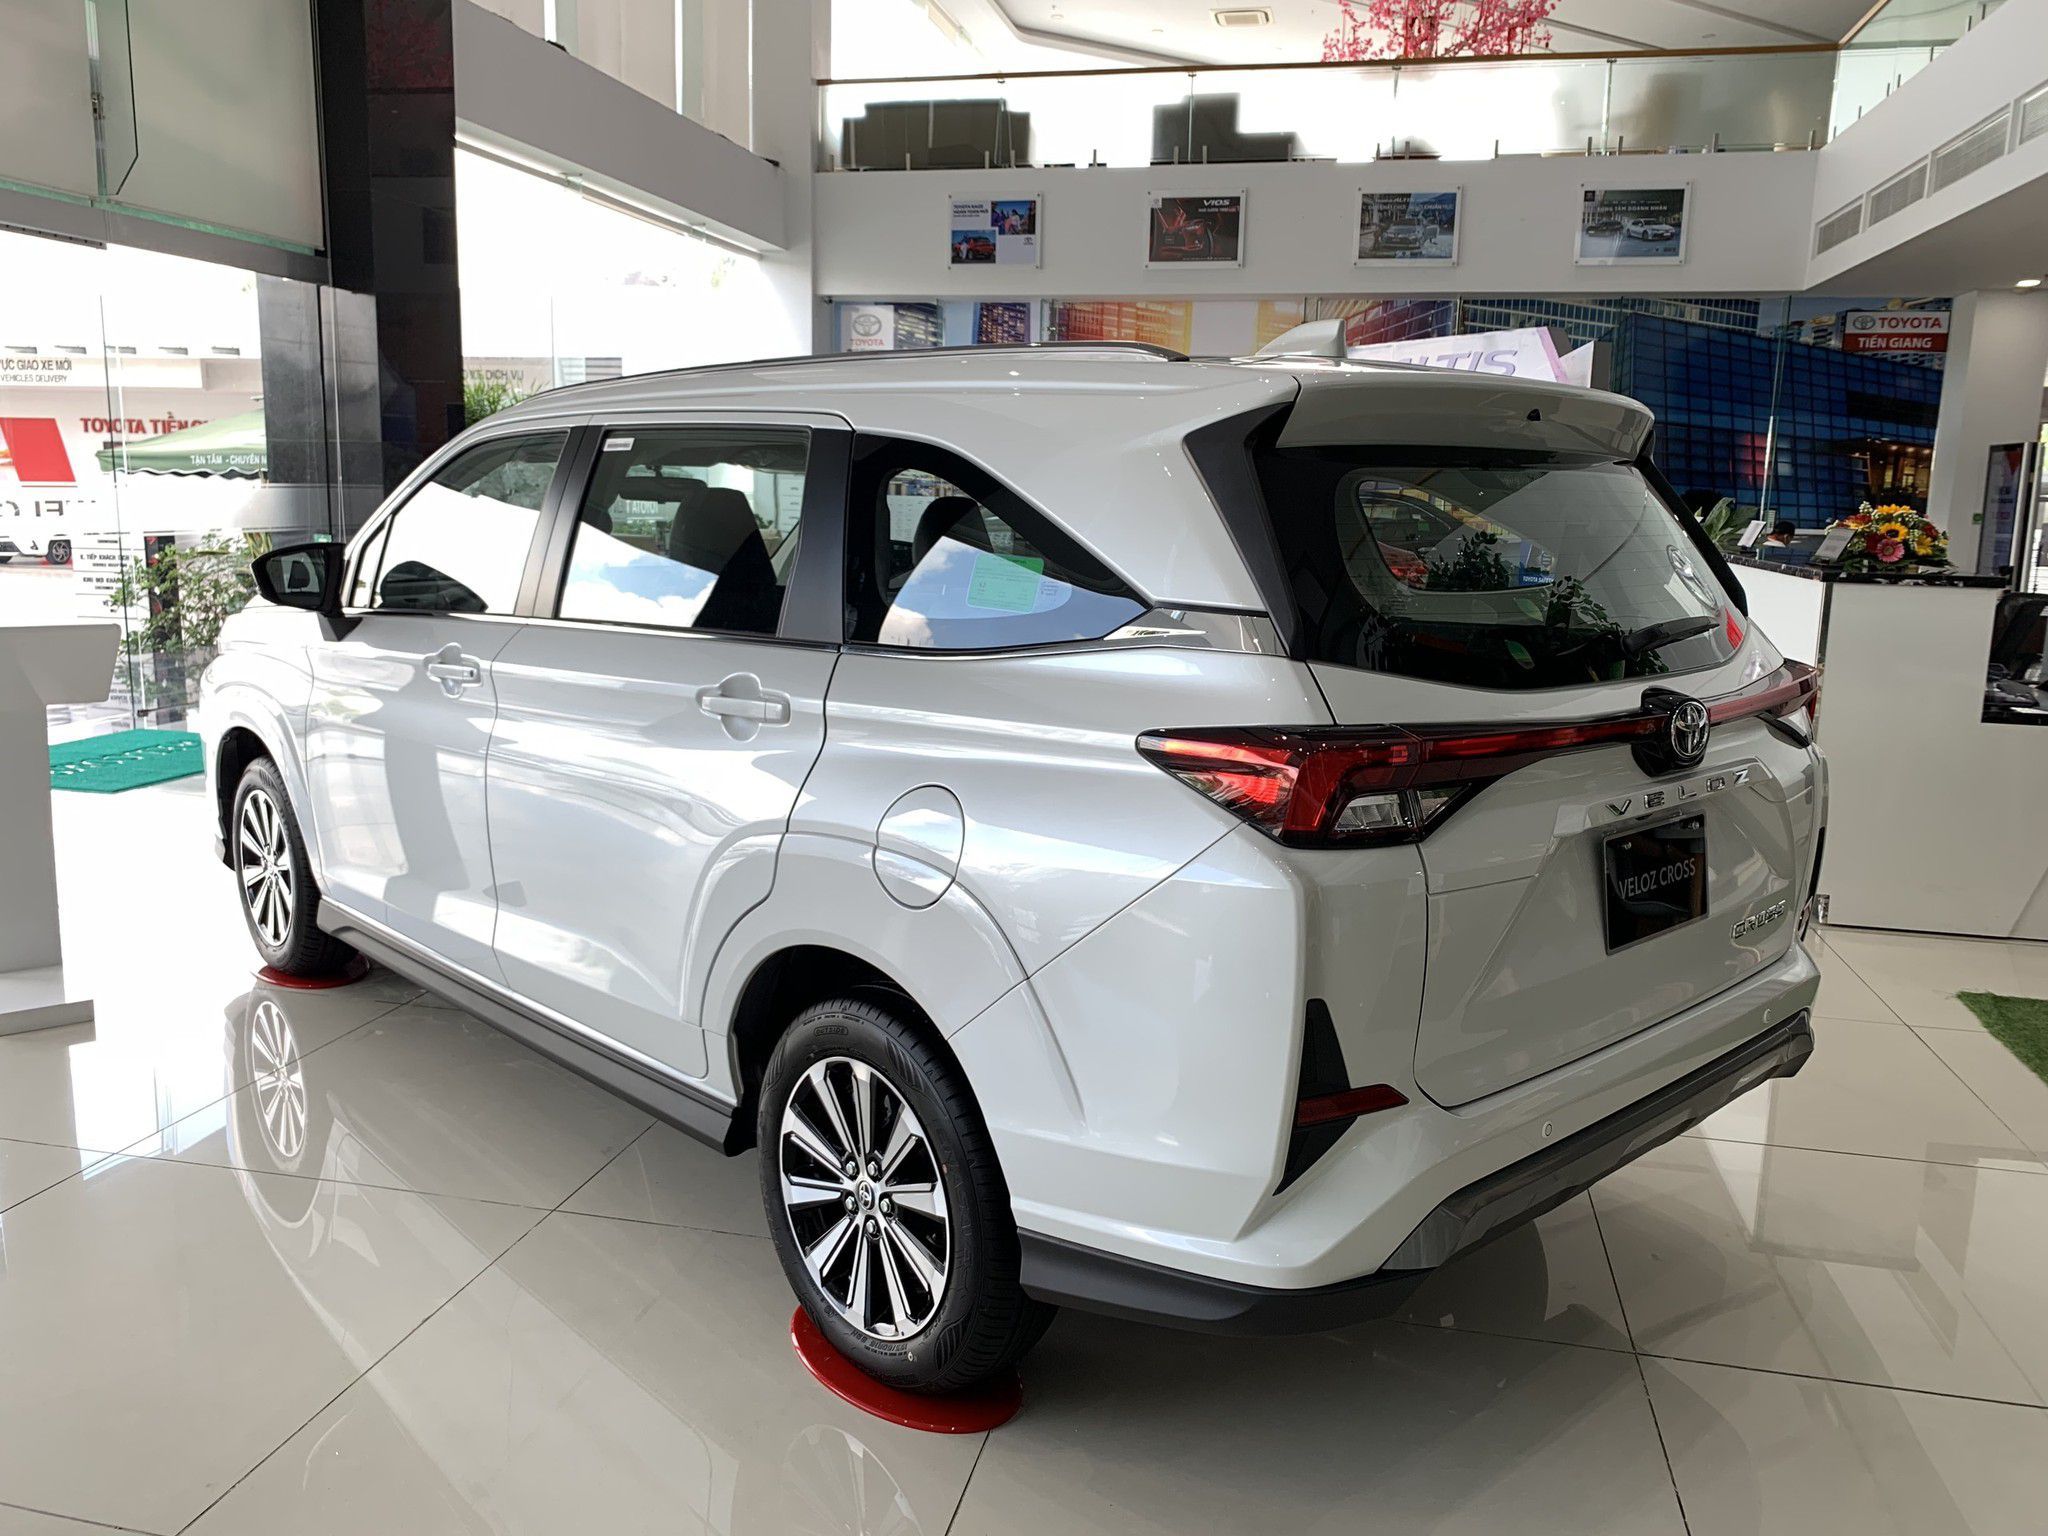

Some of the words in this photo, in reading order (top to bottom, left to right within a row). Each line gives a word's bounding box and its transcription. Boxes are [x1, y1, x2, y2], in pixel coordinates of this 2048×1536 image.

[1203, 199, 1231, 207] VIOS
[1878, 317, 1942, 329] TOYOTA
[851, 338, 884, 346] TOYOTA
[1888, 337, 1933, 349] GIANG
[41, 359, 54, 371] XE
[36, 374, 67, 383] DELIVERY
[80, 417, 147, 435] TOYOTA
[1605, 769, 1750, 816] VELOZ
[1618, 870, 1657, 900] VELOZ
[1659, 857, 1696, 886] CROSS
